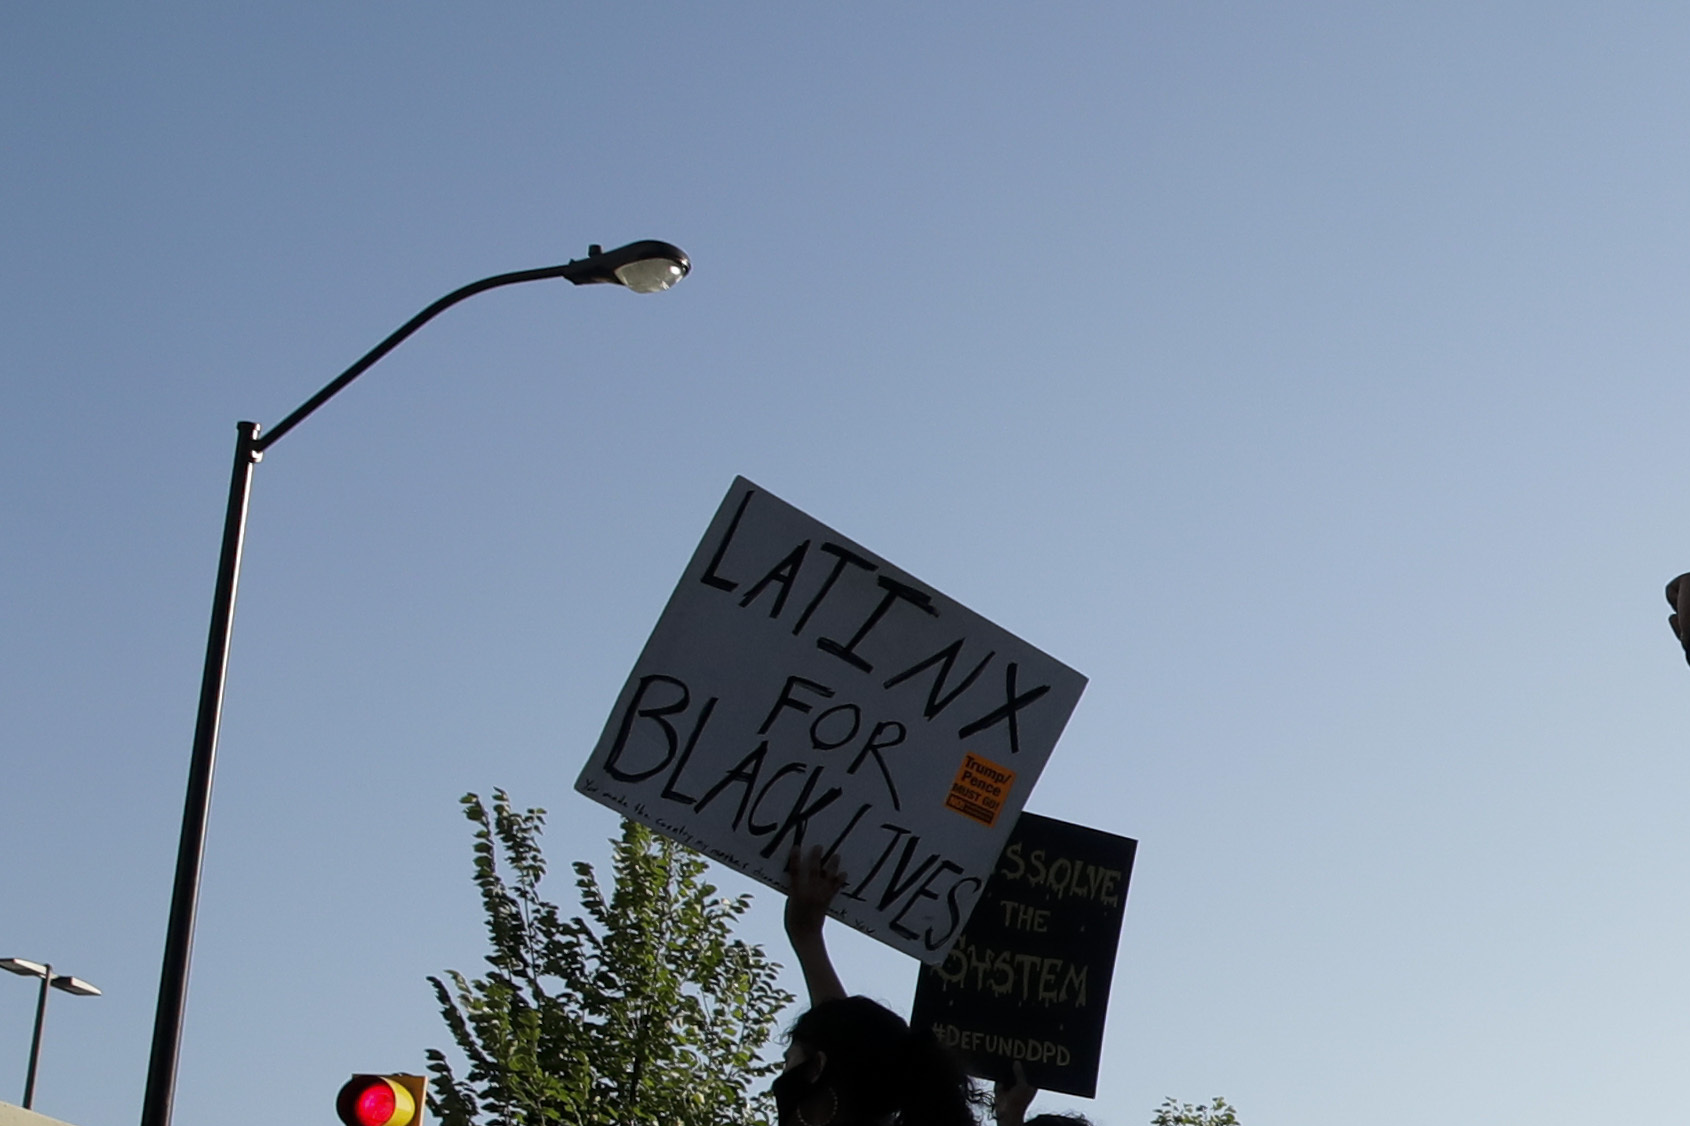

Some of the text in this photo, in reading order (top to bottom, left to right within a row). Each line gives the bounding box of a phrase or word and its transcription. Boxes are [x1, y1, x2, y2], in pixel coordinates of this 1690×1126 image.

[700, 489, 1051, 754] LATINX
[757, 675, 907, 811] FOR
[952, 783, 981, 801] MUST
[961, 770, 1001, 796] Pence
[964, 755, 1012, 785] Trump/
[603, 674, 982, 950] BLACK LIVES
[1000, 842, 1122, 906] SSOLVE
[1000, 900, 1050, 932] THE
